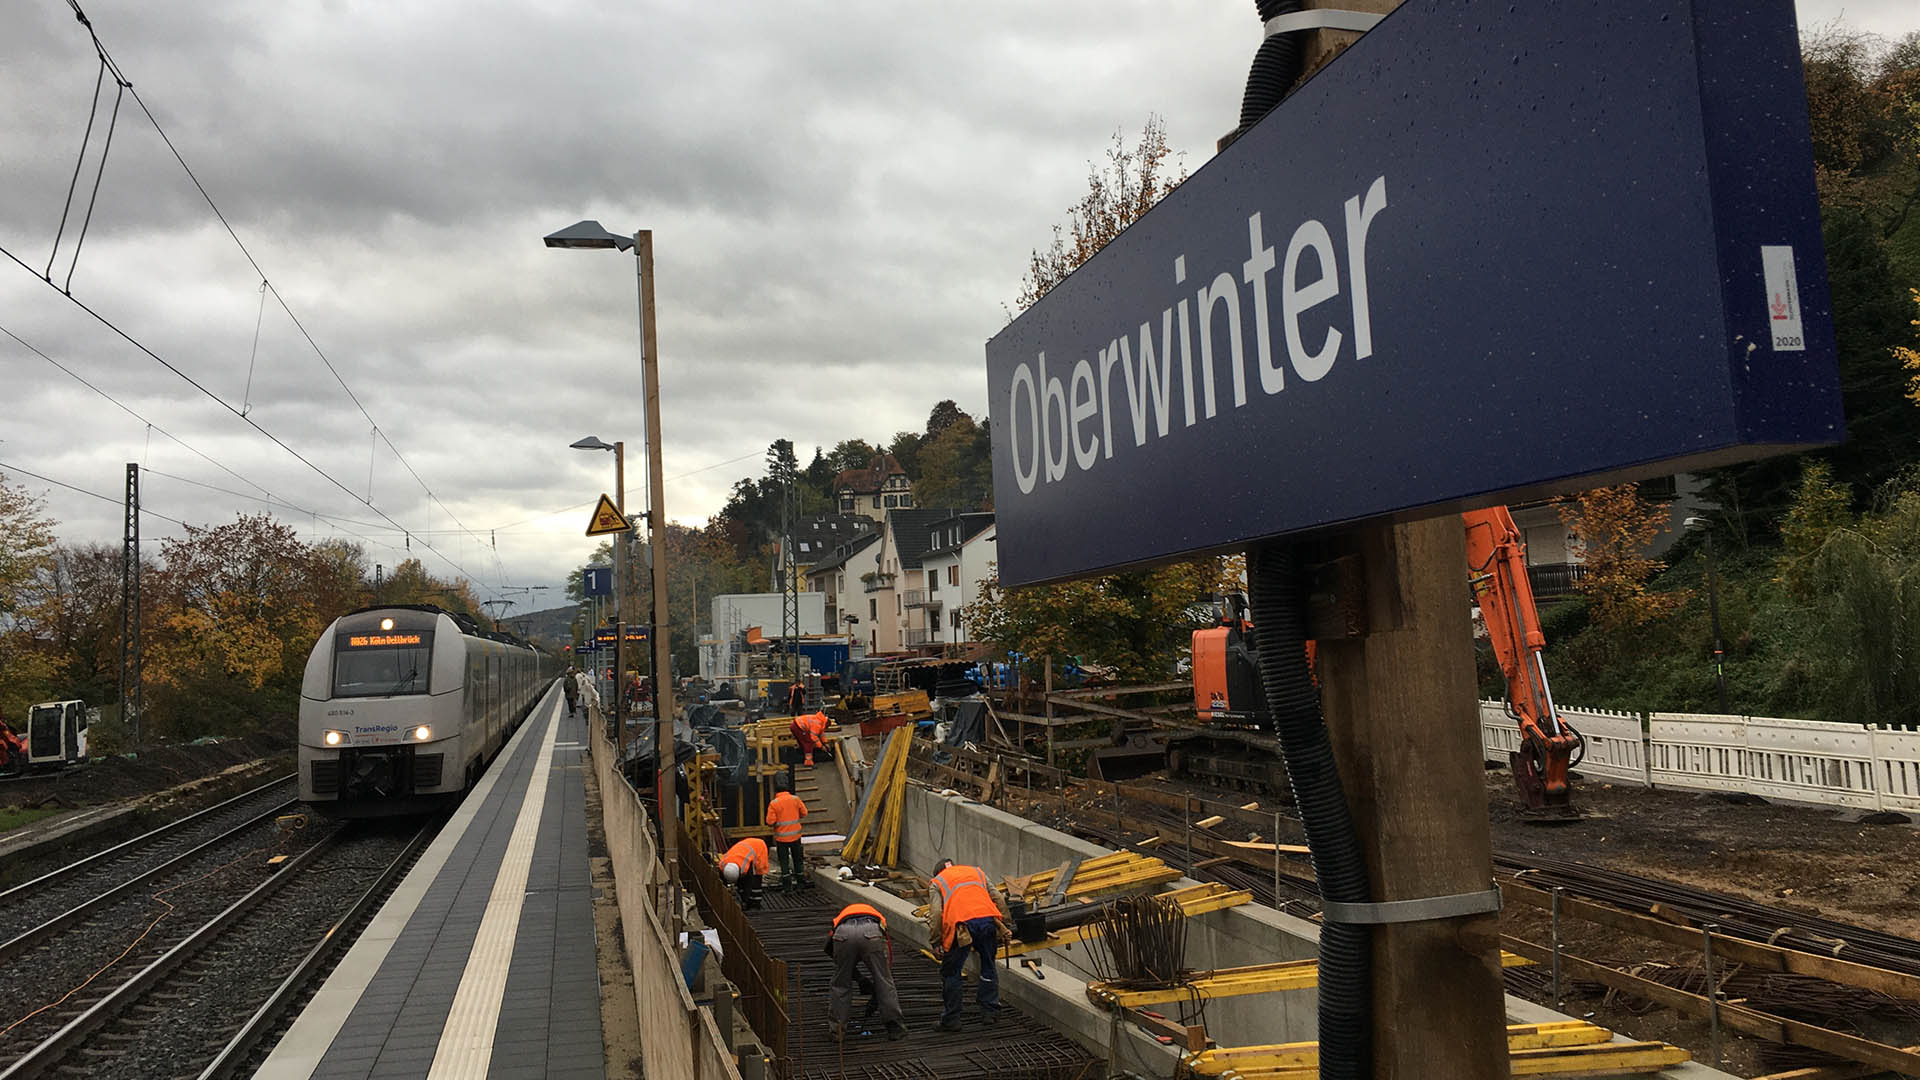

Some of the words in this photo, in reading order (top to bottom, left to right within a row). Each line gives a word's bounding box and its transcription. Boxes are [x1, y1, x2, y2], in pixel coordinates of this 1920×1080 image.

[1010, 175, 1387, 494] Oberwinter
[1776, 336, 1801, 347] 2020
[587, 570, 596, 590] 1
[369, 635, 386, 646] Köln
[355, 724, 398, 733] TransRegio
